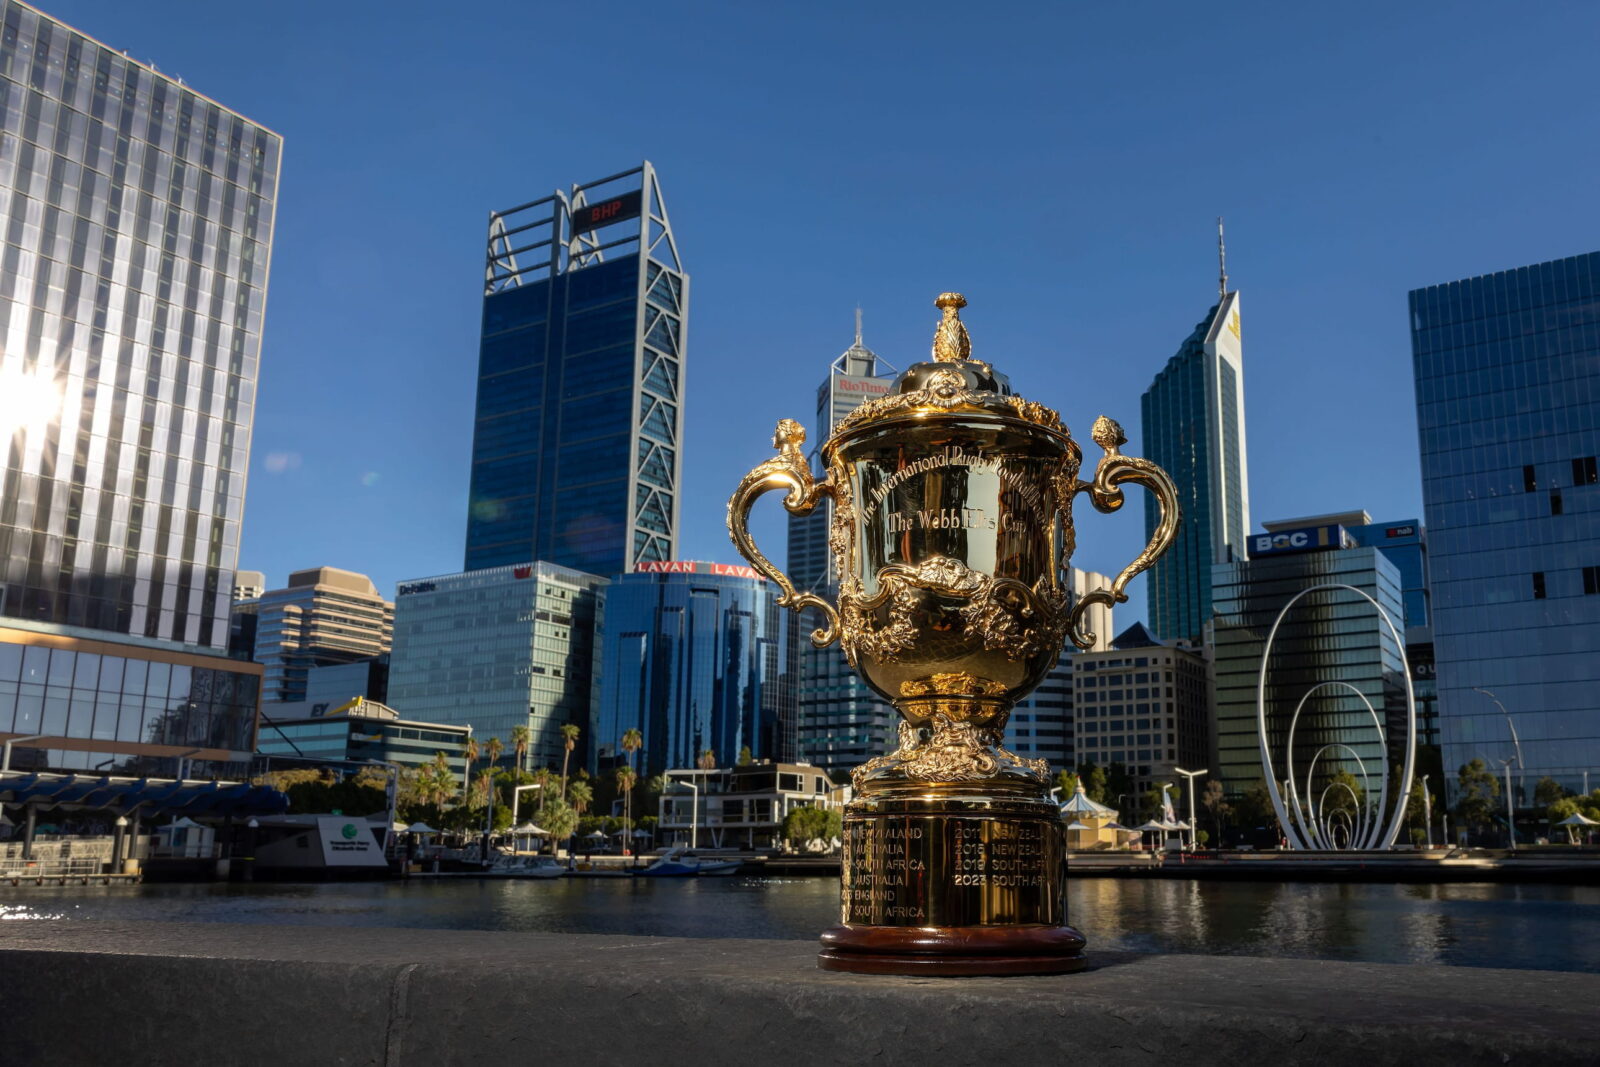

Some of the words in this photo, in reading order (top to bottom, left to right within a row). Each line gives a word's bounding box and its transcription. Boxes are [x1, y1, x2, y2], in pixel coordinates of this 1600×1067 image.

[592, 201, 623, 222] BHP
[859, 500, 878, 527] The
[870, 446, 949, 504] International
[888, 511, 913, 534] The
[917, 508, 960, 529] Webb
[1001, 511, 1027, 533] Cup
[1397, 527, 1413, 535] nab
[1256, 532, 1308, 551] BGC
[639, 562, 693, 572] LAVAN
[311, 703, 330, 717] EY
[992, 844, 1017, 855] NEW
[886, 859, 926, 870] AFRICA
[992, 860, 1028, 871] SOUTH
[954, 874, 987, 886] 2023
[992, 875, 1029, 886] SOUTH
[854, 890, 895, 901] ENGLAND
[854, 905, 883, 917] SOUTH
[885, 907, 925, 918] AFRICA
